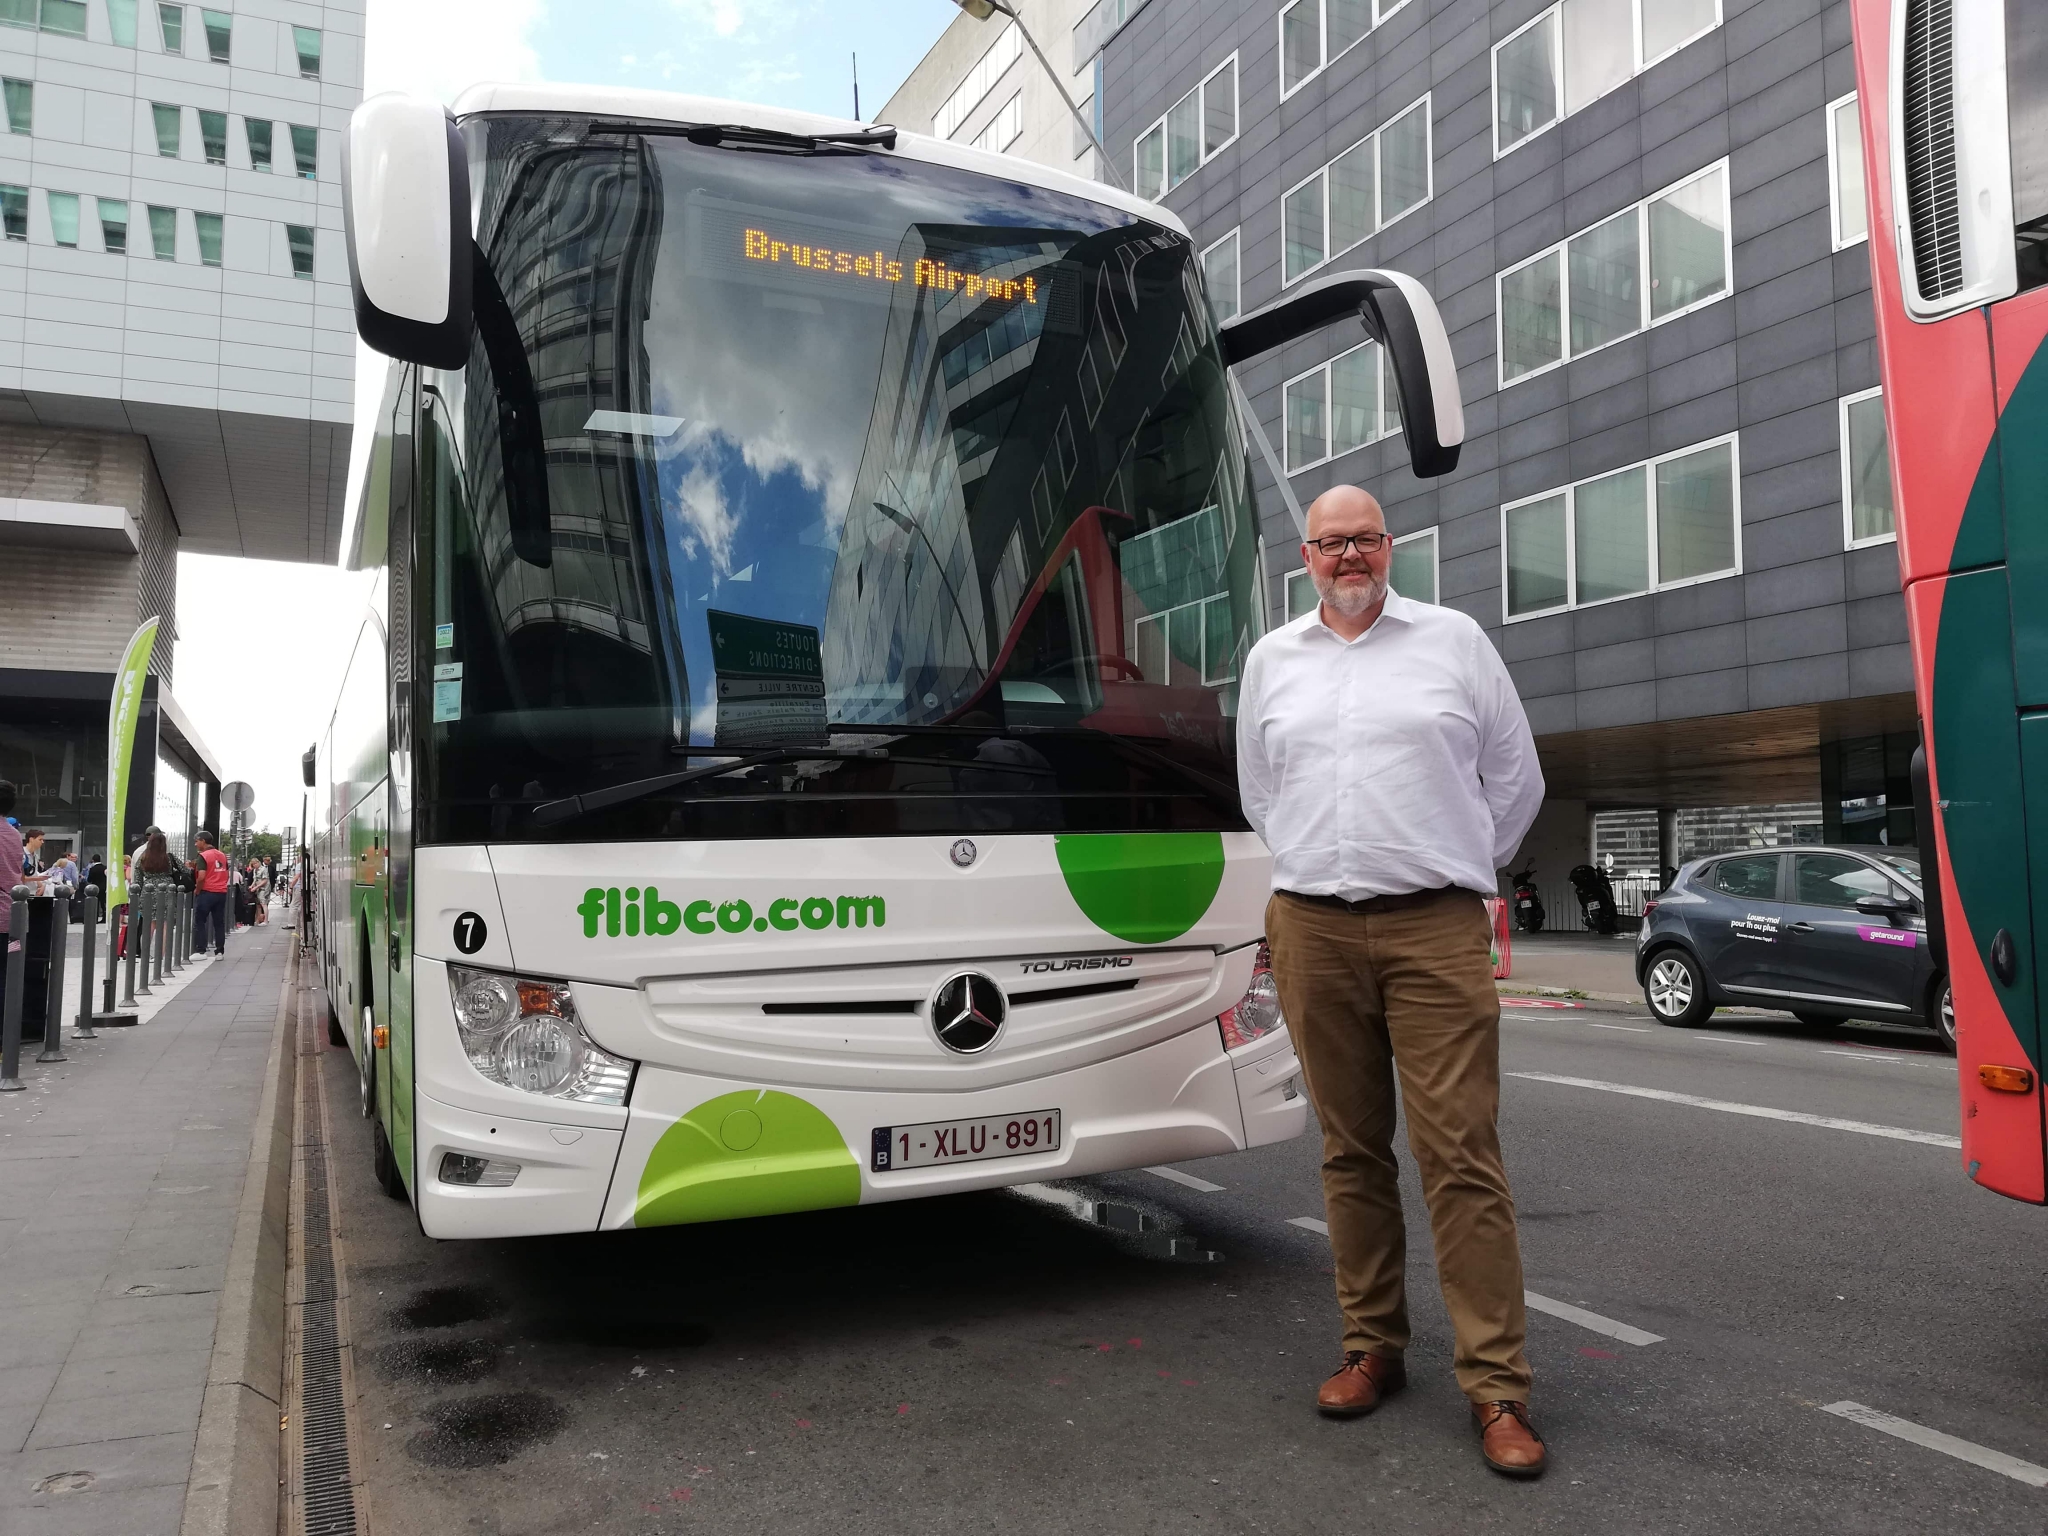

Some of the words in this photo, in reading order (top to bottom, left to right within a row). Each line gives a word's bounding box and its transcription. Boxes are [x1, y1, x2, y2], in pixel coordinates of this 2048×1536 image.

[745, 228, 903, 282] Brussels
[914, 257, 1037, 304] Airport
[39, 785, 57, 797] de
[78, 780, 105, 798] Lil
[577, 885, 886, 939] flibco.com
[1746, 912, 1781, 925] Louez-moi
[461, 917, 476, 949] 7
[1730, 920, 1746, 928] pour
[1762, 923, 1778, 933] plus.
[1869, 931, 1905, 942] getaround
[1019, 955, 1133, 974] TOURISMO
[899, 1117, 1053, 1162] 1-XLU-891
[876, 1151, 888, 1166] B
